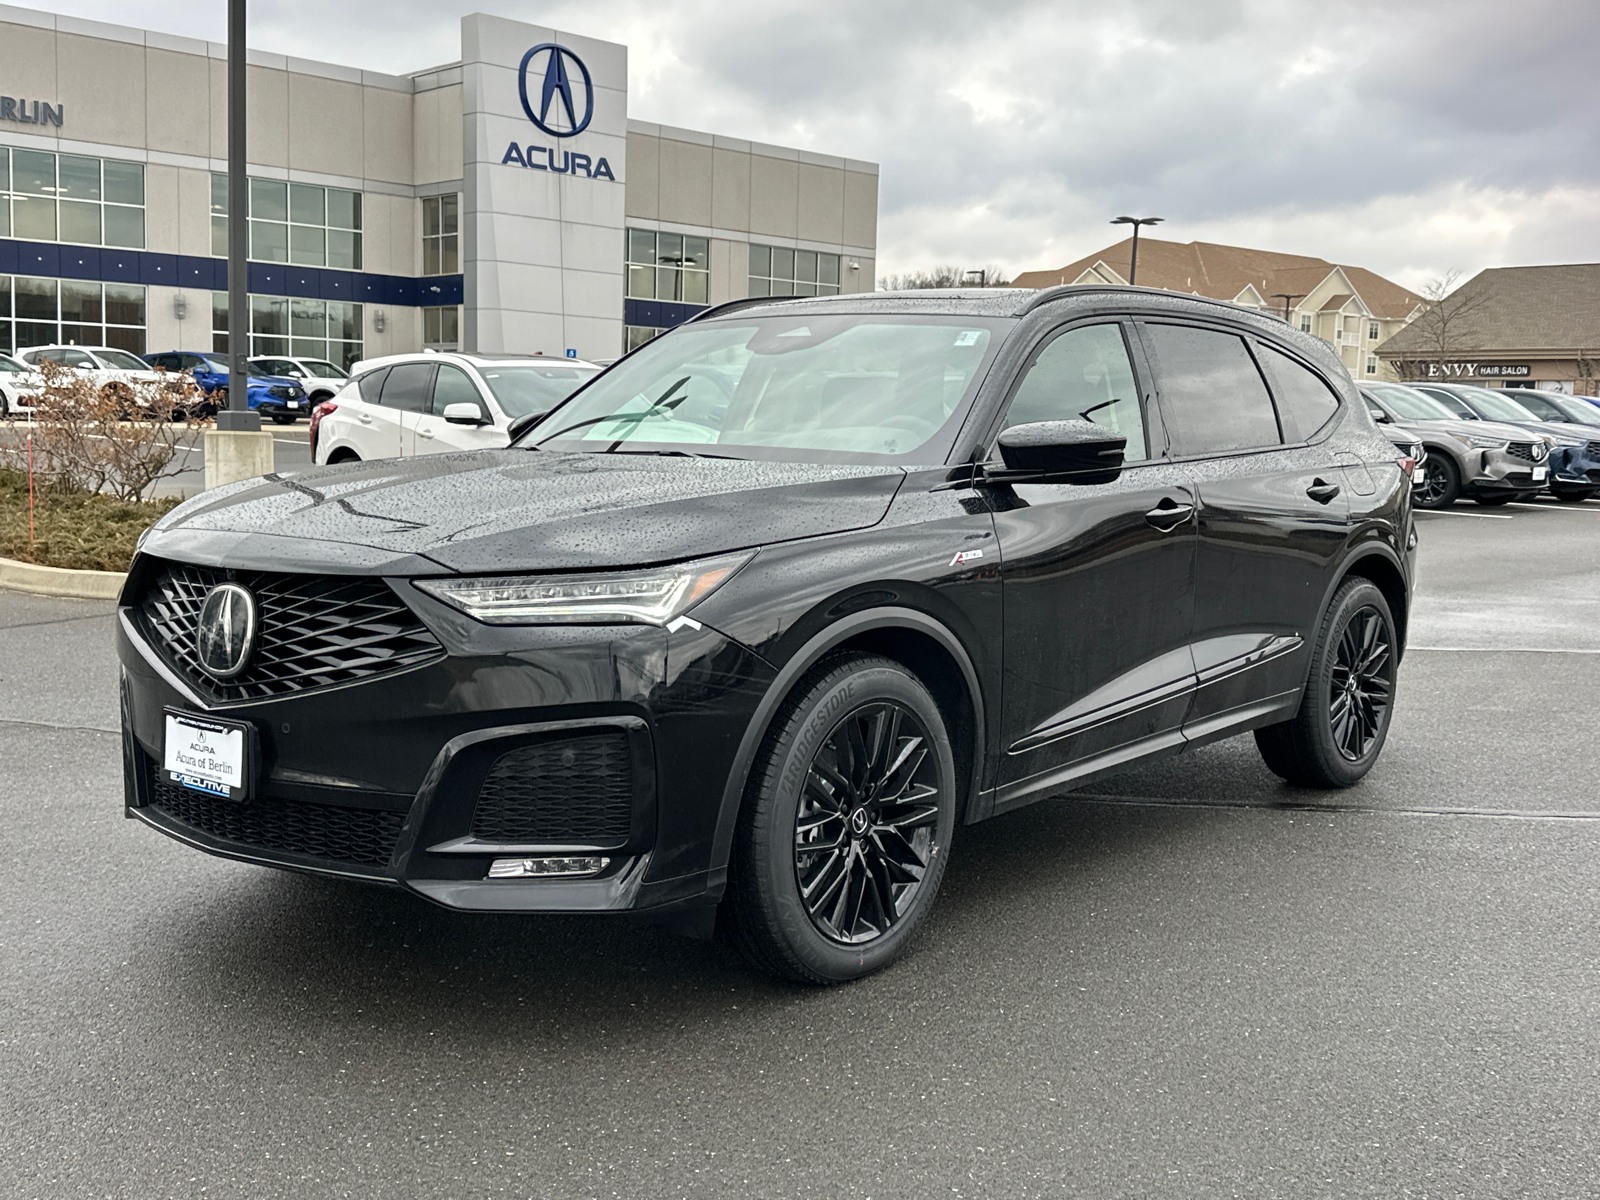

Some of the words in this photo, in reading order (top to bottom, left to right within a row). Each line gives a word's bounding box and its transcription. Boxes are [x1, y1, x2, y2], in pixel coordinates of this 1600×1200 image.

[0, 96, 63, 127] RLIN
[501, 141, 615, 181] ACURA
[1428, 363, 1478, 377] ENVY
[1480, 366, 1500, 375] HAIR
[1501, 366, 1528, 375] SALON
[190, 743, 216, 755] ACURA
[781, 682, 855, 797] BRIDGESTONE
[175, 750, 197, 766] Acura
[198, 758, 206, 769] of
[208, 758, 233, 775] Berlin
[170, 771, 231, 794] EXECUTIVE
